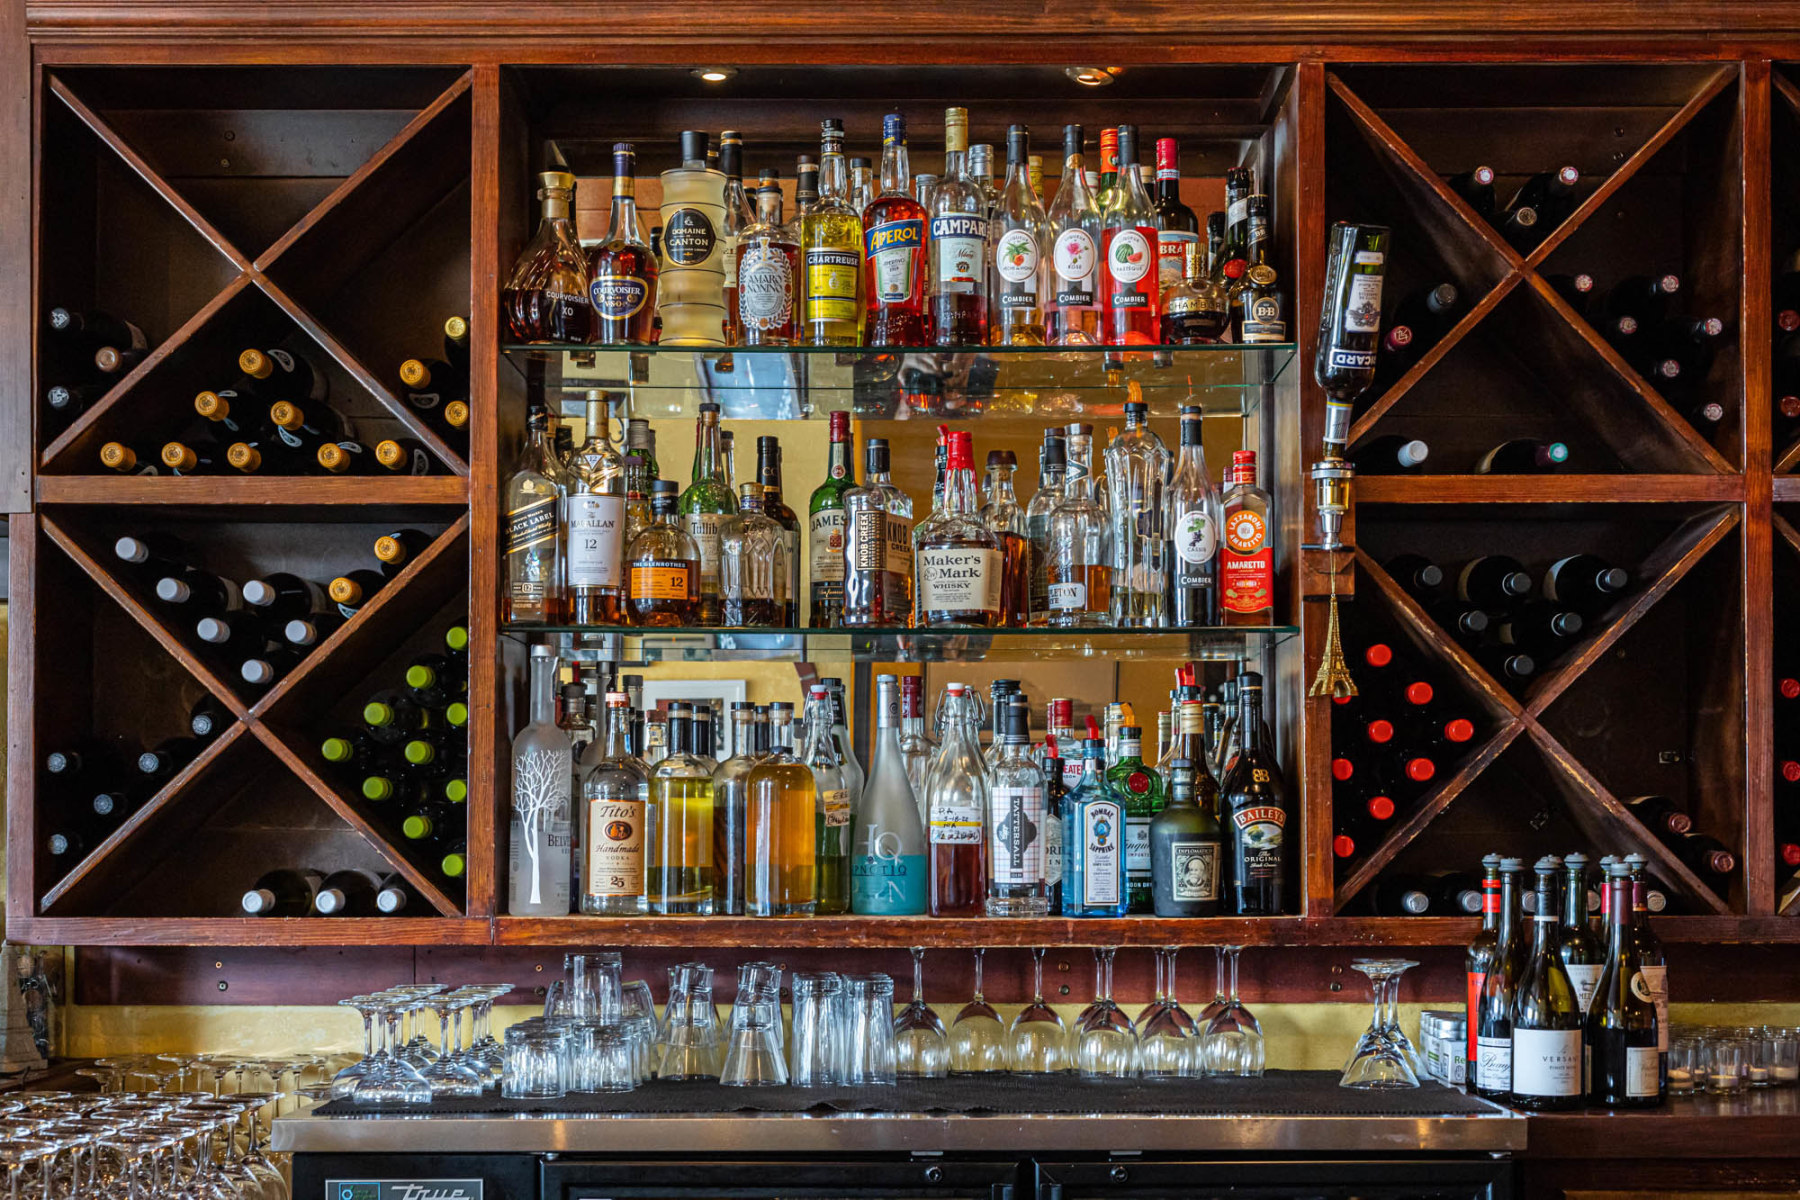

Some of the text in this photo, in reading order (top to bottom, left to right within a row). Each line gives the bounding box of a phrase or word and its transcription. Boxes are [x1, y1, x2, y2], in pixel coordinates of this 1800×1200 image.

[671, 227, 707, 235] DOMAINE
[669, 238, 709, 246] CANTON
[870, 227, 918, 251] APEROL
[808, 255, 859, 266] CHARTREUSE
[748, 274, 783, 286] AMARO
[594, 286, 641, 296] COURVOISIER
[747, 283, 783, 294] NONINO
[546, 290, 590, 305] COURVOISIER
[1001, 295, 1034, 304] COMBIER
[1058, 294, 1091, 304] COMBIER
[1113, 295, 1146, 304] COMBIER
[561, 306, 574, 316] XO
[505, 520, 529, 534] BLACK
[529, 512, 554, 525] LABEL
[570, 520, 615, 528] MACALLAN
[811, 514, 845, 532] JAMES
[1229, 513, 1263, 530] LAZZARONI
[692, 522, 718, 535] Tullib
[887, 520, 908, 545] KNOB
[585, 539, 597, 549] 12
[860, 514, 869, 567] KNOB CREEK
[1229, 532, 1263, 548] AMARETTO
[891, 543, 911, 553] CREEK
[923, 555, 982, 566] Maker's
[1226, 560, 1266, 569] AMARETTO
[939, 567, 982, 579] Mark
[670, 576, 684, 588] 12
[932, 582, 972, 590] WHISKY
[1180, 576, 1213, 585] COMBIER
[1049, 587, 1078, 598] LETON
[600, 805, 636, 818] Tito's
[1090, 809, 1114, 819] BOMBAY
[1239, 809, 1285, 824] BAILEYS
[1013, 798, 1021, 867] TATTERSALL
[595, 843, 640, 853] Handmade
[1088, 843, 1115, 854] SAPPHIRE
[610, 876, 625, 888] 25
[1454, 1055, 1466, 1065] Re
